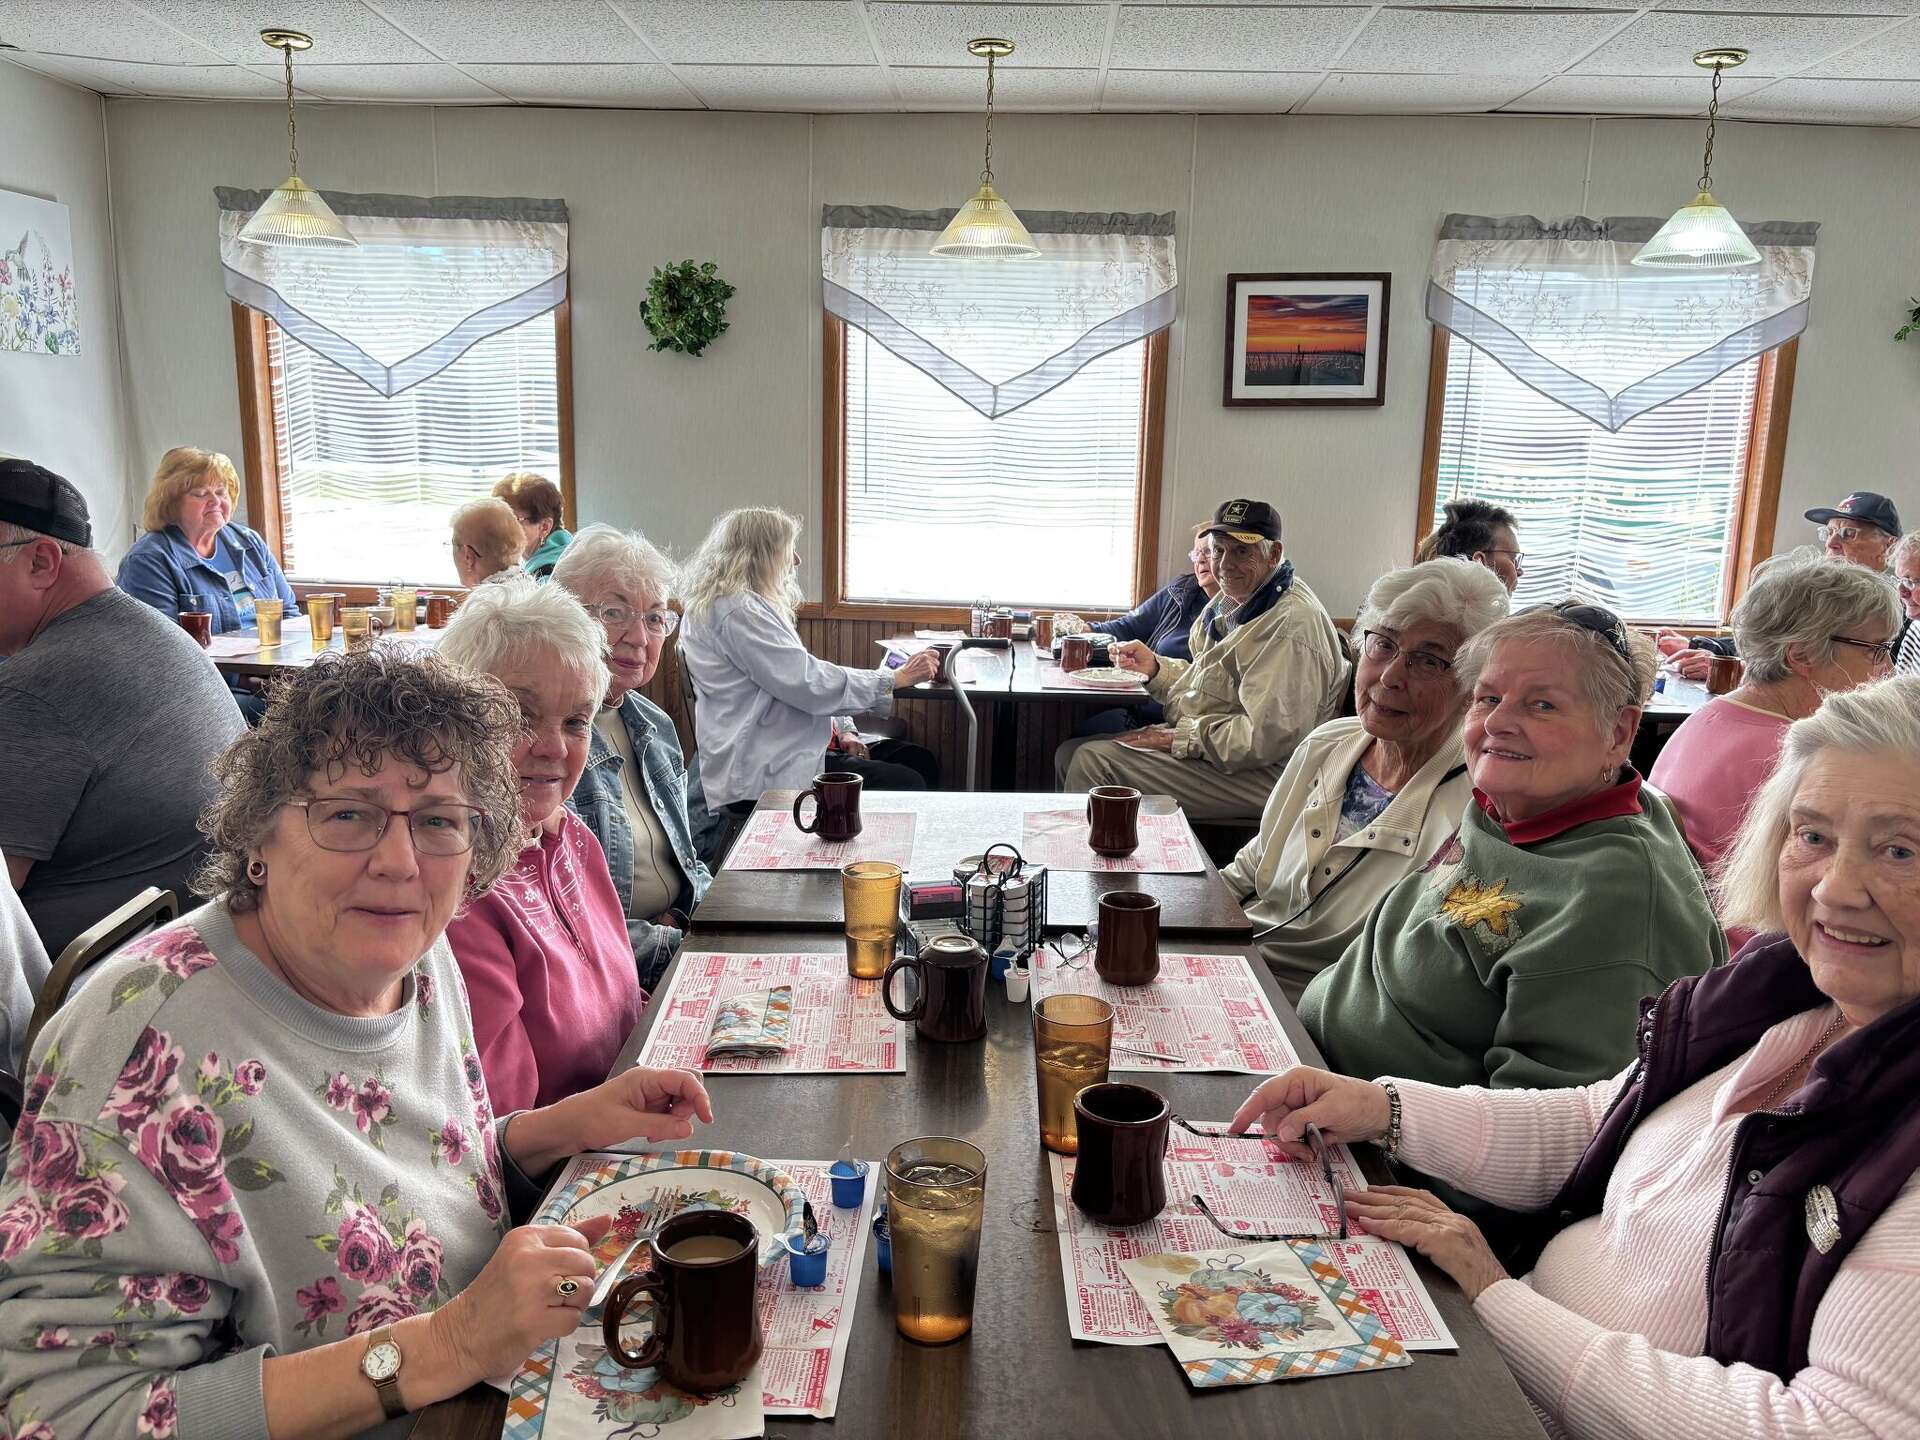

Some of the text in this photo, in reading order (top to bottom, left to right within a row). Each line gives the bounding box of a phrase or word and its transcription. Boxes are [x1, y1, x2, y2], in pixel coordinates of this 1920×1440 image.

[1160, 1218, 1176, 1239] WALK
[1171, 1218, 1190, 1252] WARMTH
[1331, 1242, 1349, 1264] TOWING
[1113, 1275, 1121, 1283] ALL
[1079, 1286, 1093, 1330] REDEEMED
